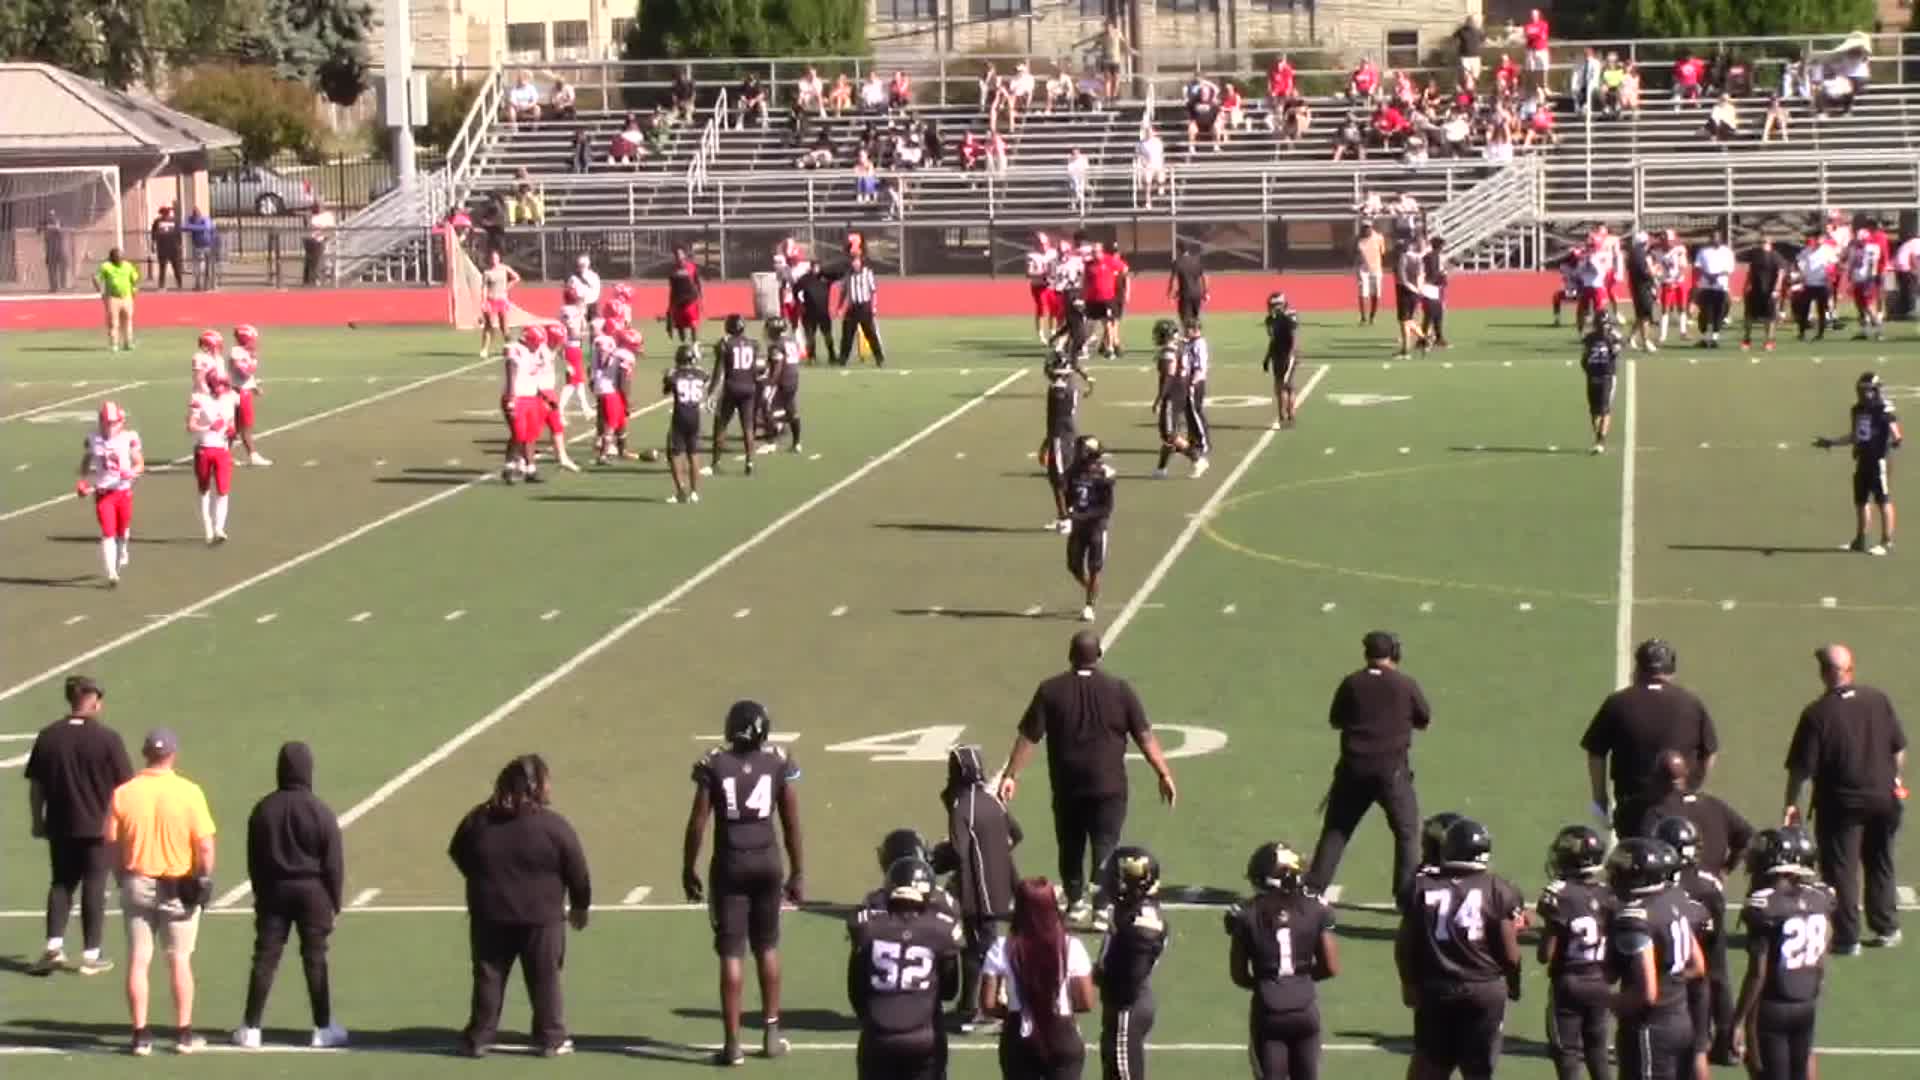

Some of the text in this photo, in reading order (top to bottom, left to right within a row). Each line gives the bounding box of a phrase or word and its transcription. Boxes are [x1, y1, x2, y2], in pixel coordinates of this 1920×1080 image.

[732, 345, 754, 370] 10
[675, 377, 705, 403] 96
[721, 775, 773, 820] 14
[1424, 888, 1484, 941] 74
[1276, 927, 1295, 977] 1
[1568, 916, 1605, 961] 2
[1780, 914, 1828, 970] 28
[870, 939, 936, 991] 52
